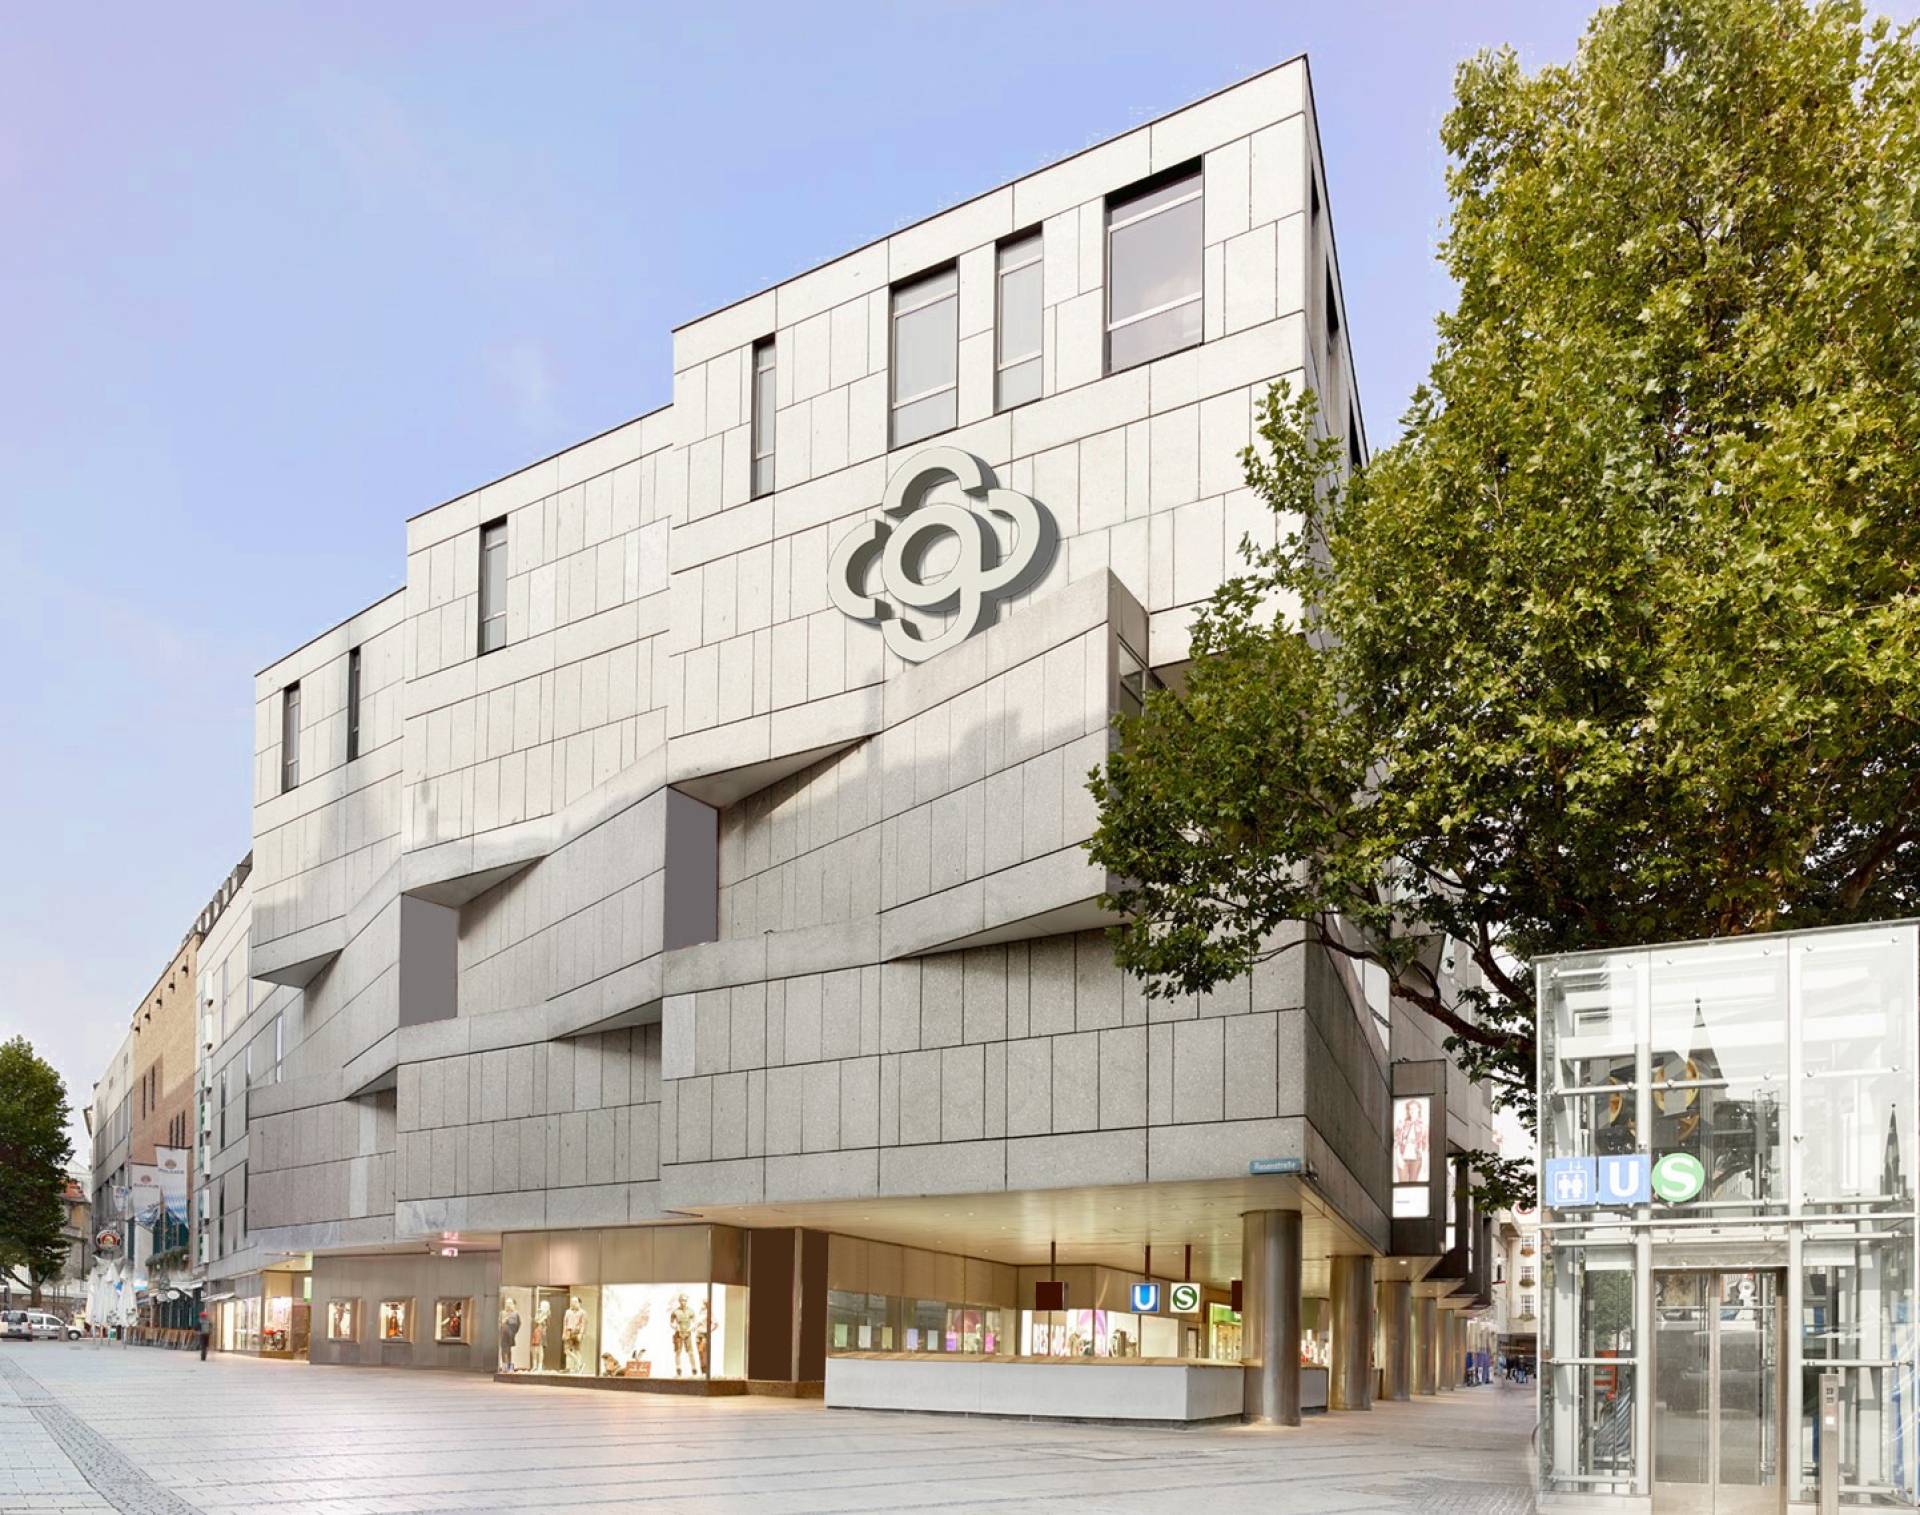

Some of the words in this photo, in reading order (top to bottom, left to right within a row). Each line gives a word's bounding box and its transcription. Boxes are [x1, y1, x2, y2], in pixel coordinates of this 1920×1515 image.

[1609, 1160, 1640, 1198] U
[1661, 1156, 1697, 1198] S
[1134, 1285, 1156, 1311] U
[1176, 1287, 1194, 1309] S
